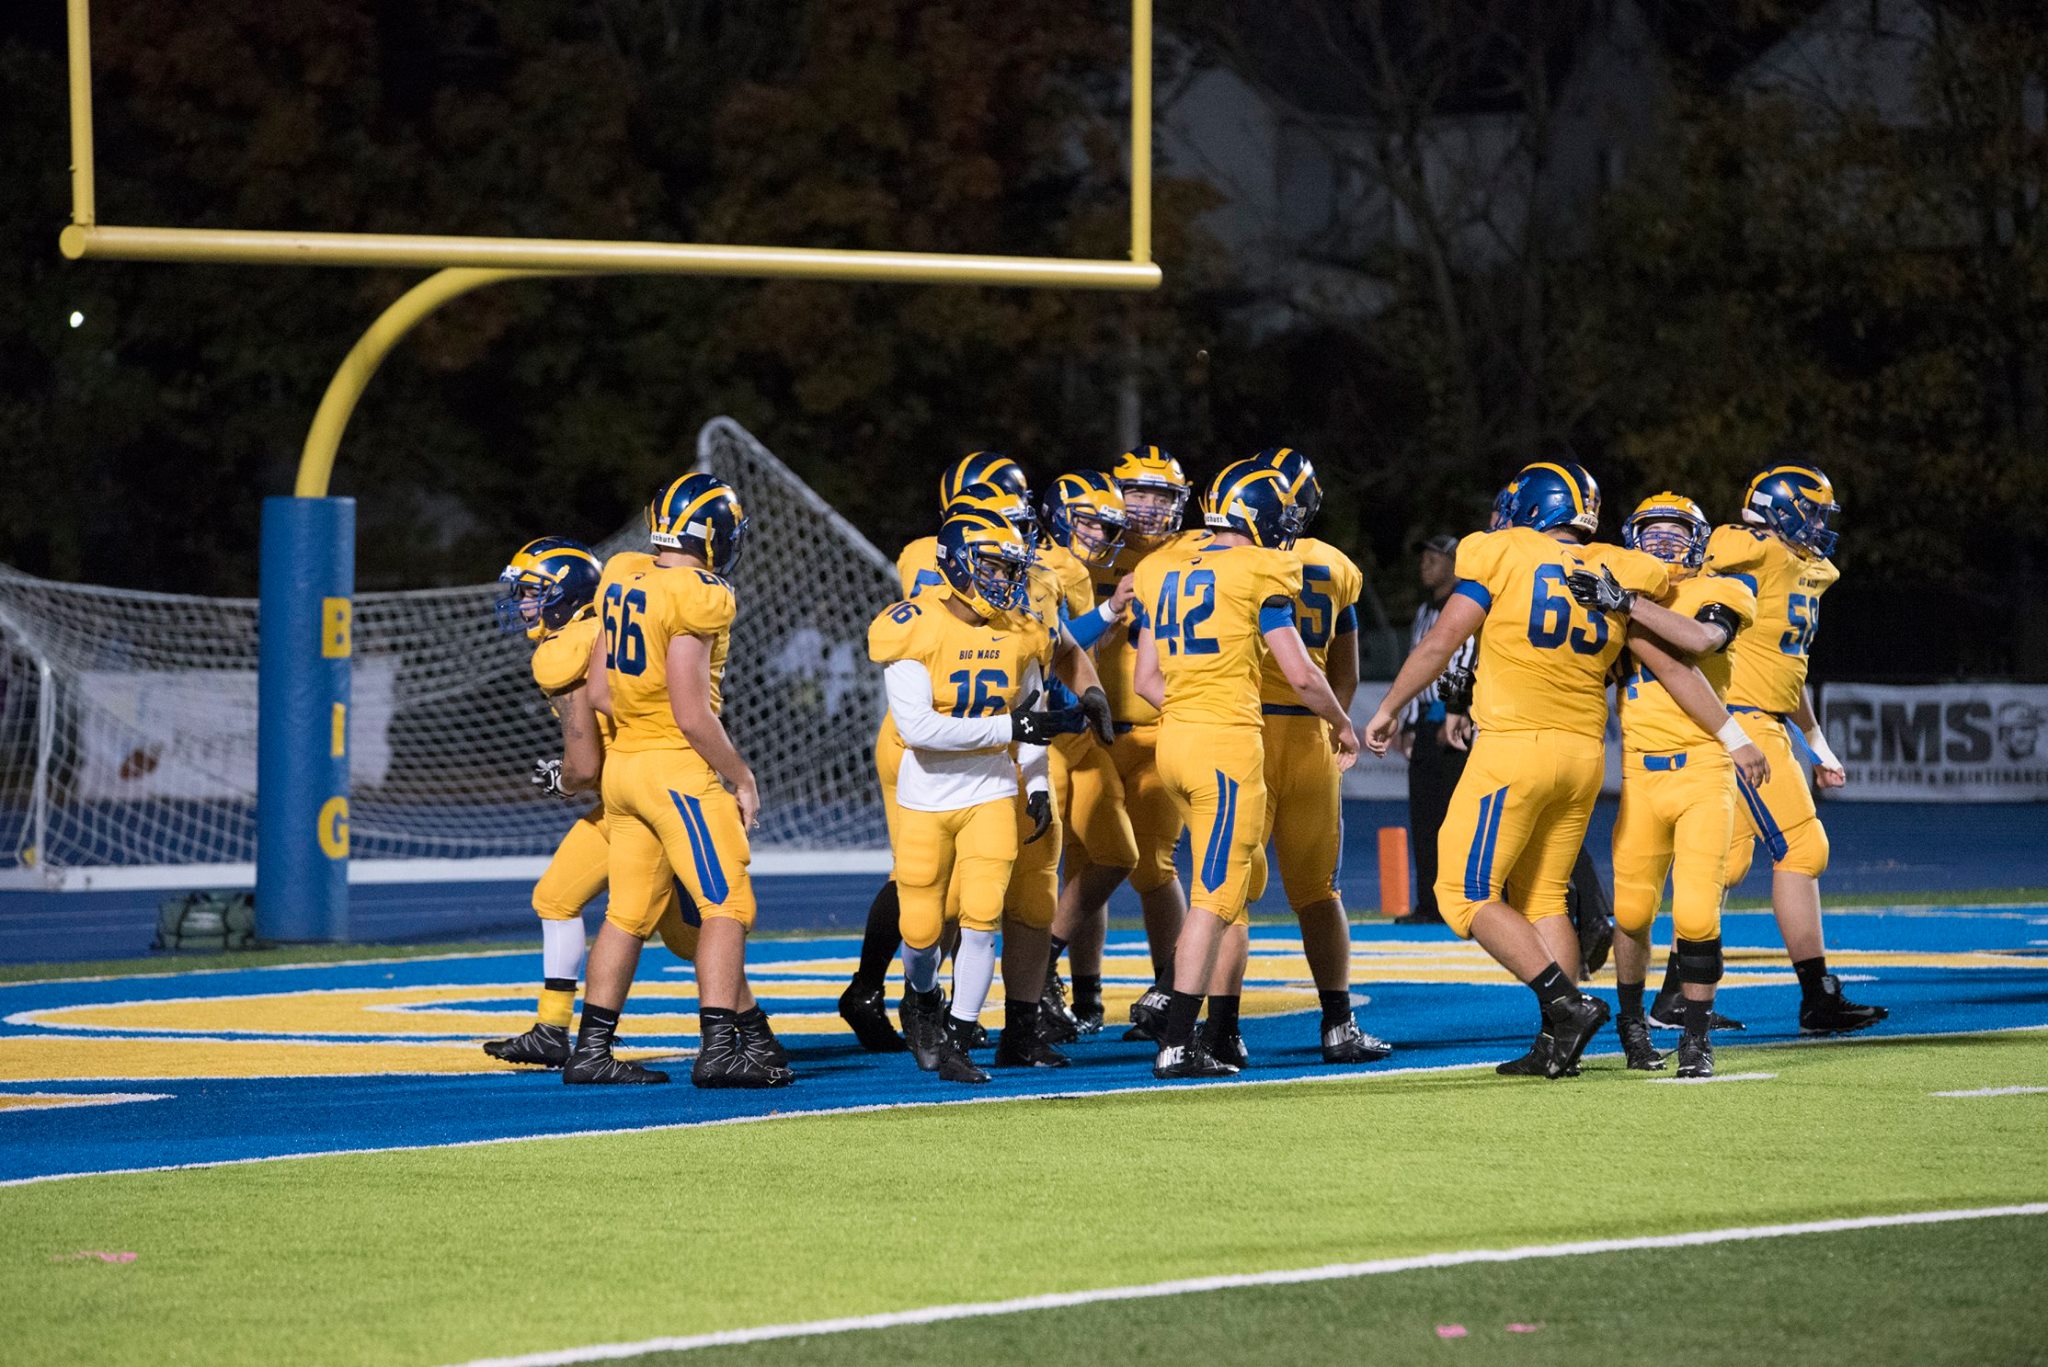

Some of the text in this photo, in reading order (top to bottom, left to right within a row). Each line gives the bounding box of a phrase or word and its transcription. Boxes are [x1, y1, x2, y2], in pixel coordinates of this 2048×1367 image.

[602, 582, 648, 677] 66
[886, 601, 923, 625] 16
[1154, 569, 1221, 656] 42
[1527, 563, 1609, 656] 63
[959, 650, 1000, 660] BIG MACS
[949, 668, 1009, 719] 16
[1826, 701, 1994, 763] GMS
[1137, 991, 1171, 1011] NIKE
[1155, 1046, 1185, 1069] NIKE
